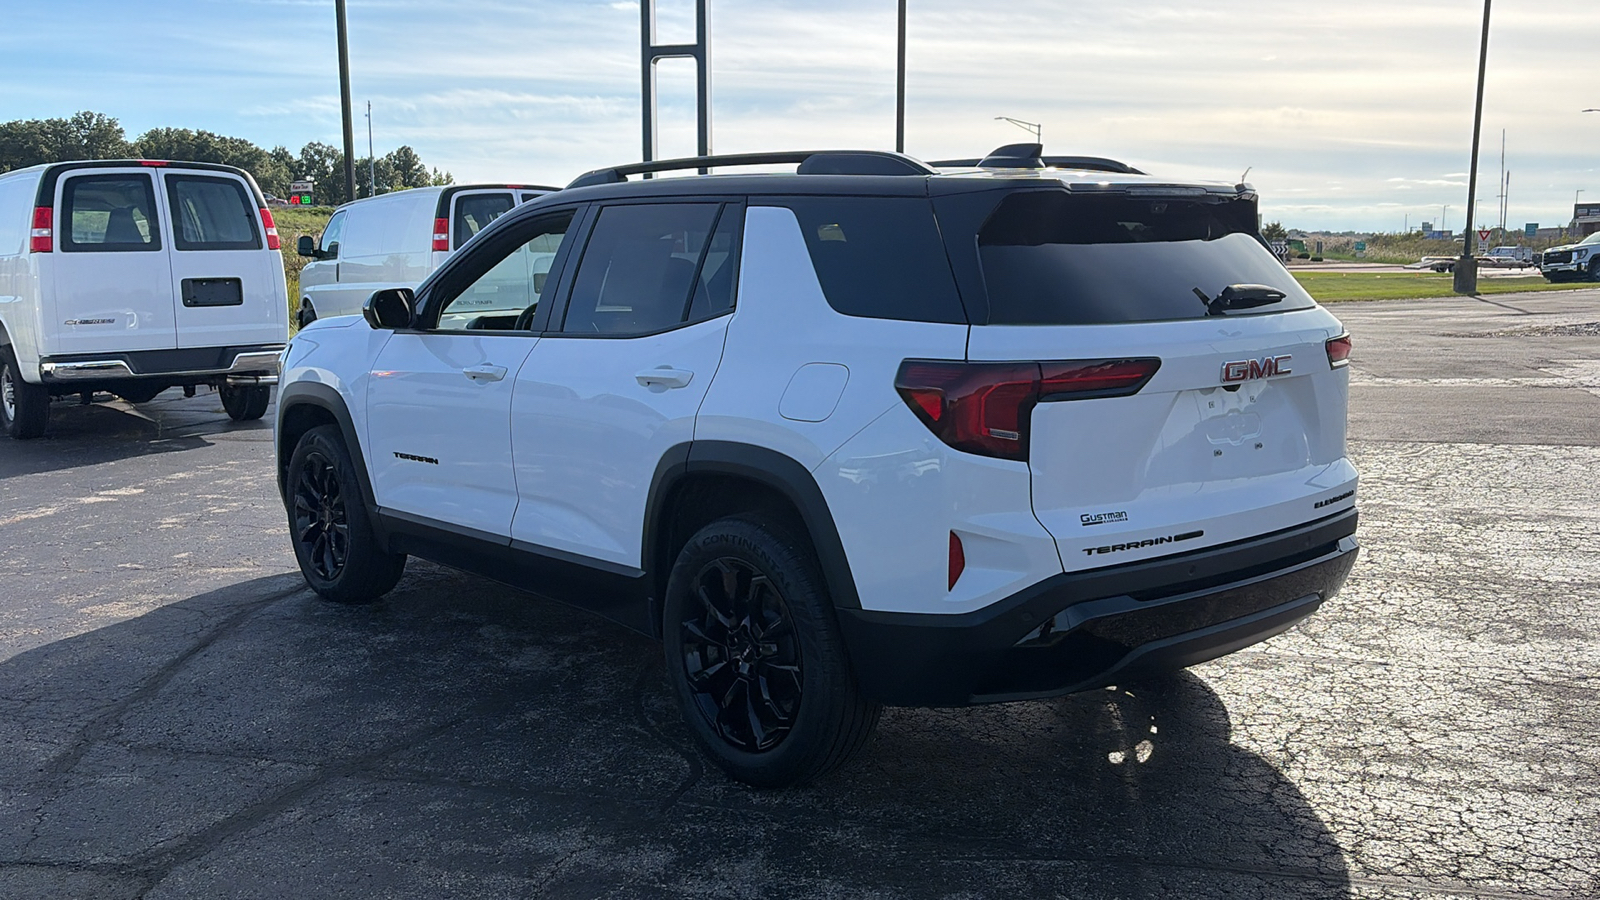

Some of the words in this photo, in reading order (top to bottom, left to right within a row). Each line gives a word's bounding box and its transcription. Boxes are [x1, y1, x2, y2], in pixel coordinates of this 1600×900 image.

[1219, 353, 1293, 384] GMC
[392, 451, 439, 465] TERRAIN
[1081, 535, 1173, 556] TERRAIN
